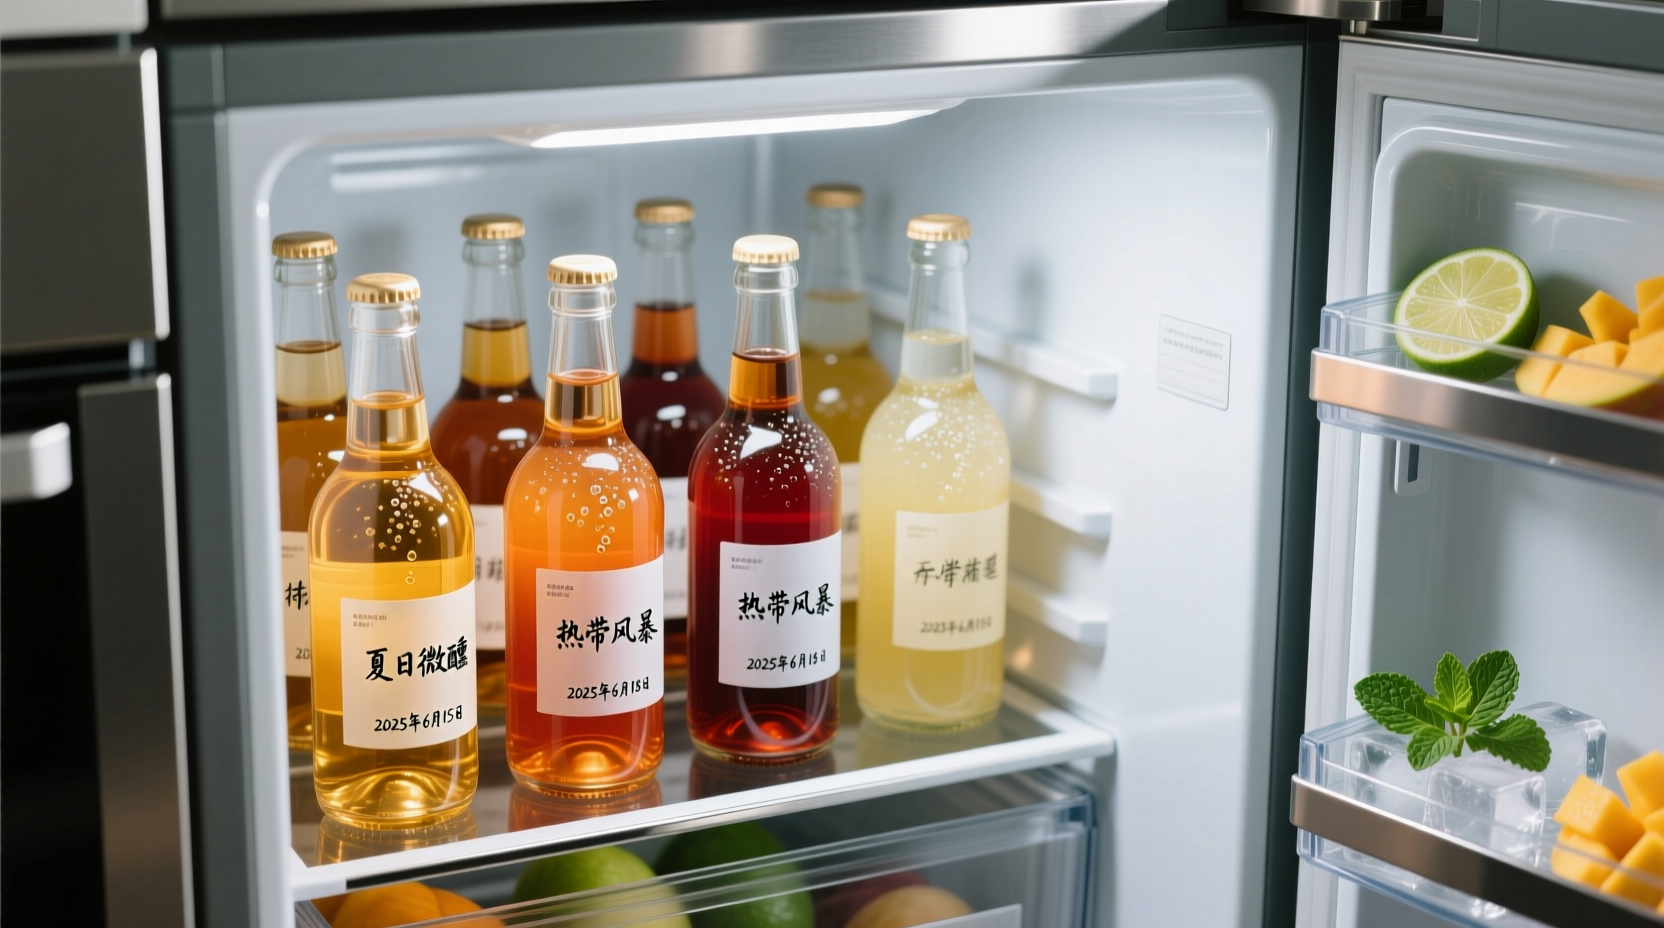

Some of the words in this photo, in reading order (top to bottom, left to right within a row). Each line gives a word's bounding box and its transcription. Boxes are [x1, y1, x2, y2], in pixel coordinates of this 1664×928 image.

[738, 583, 834, 625] 热带风暴
[556, 608, 658, 653] 热带风暴
[373, 704, 463, 733] 2025年6月15日
